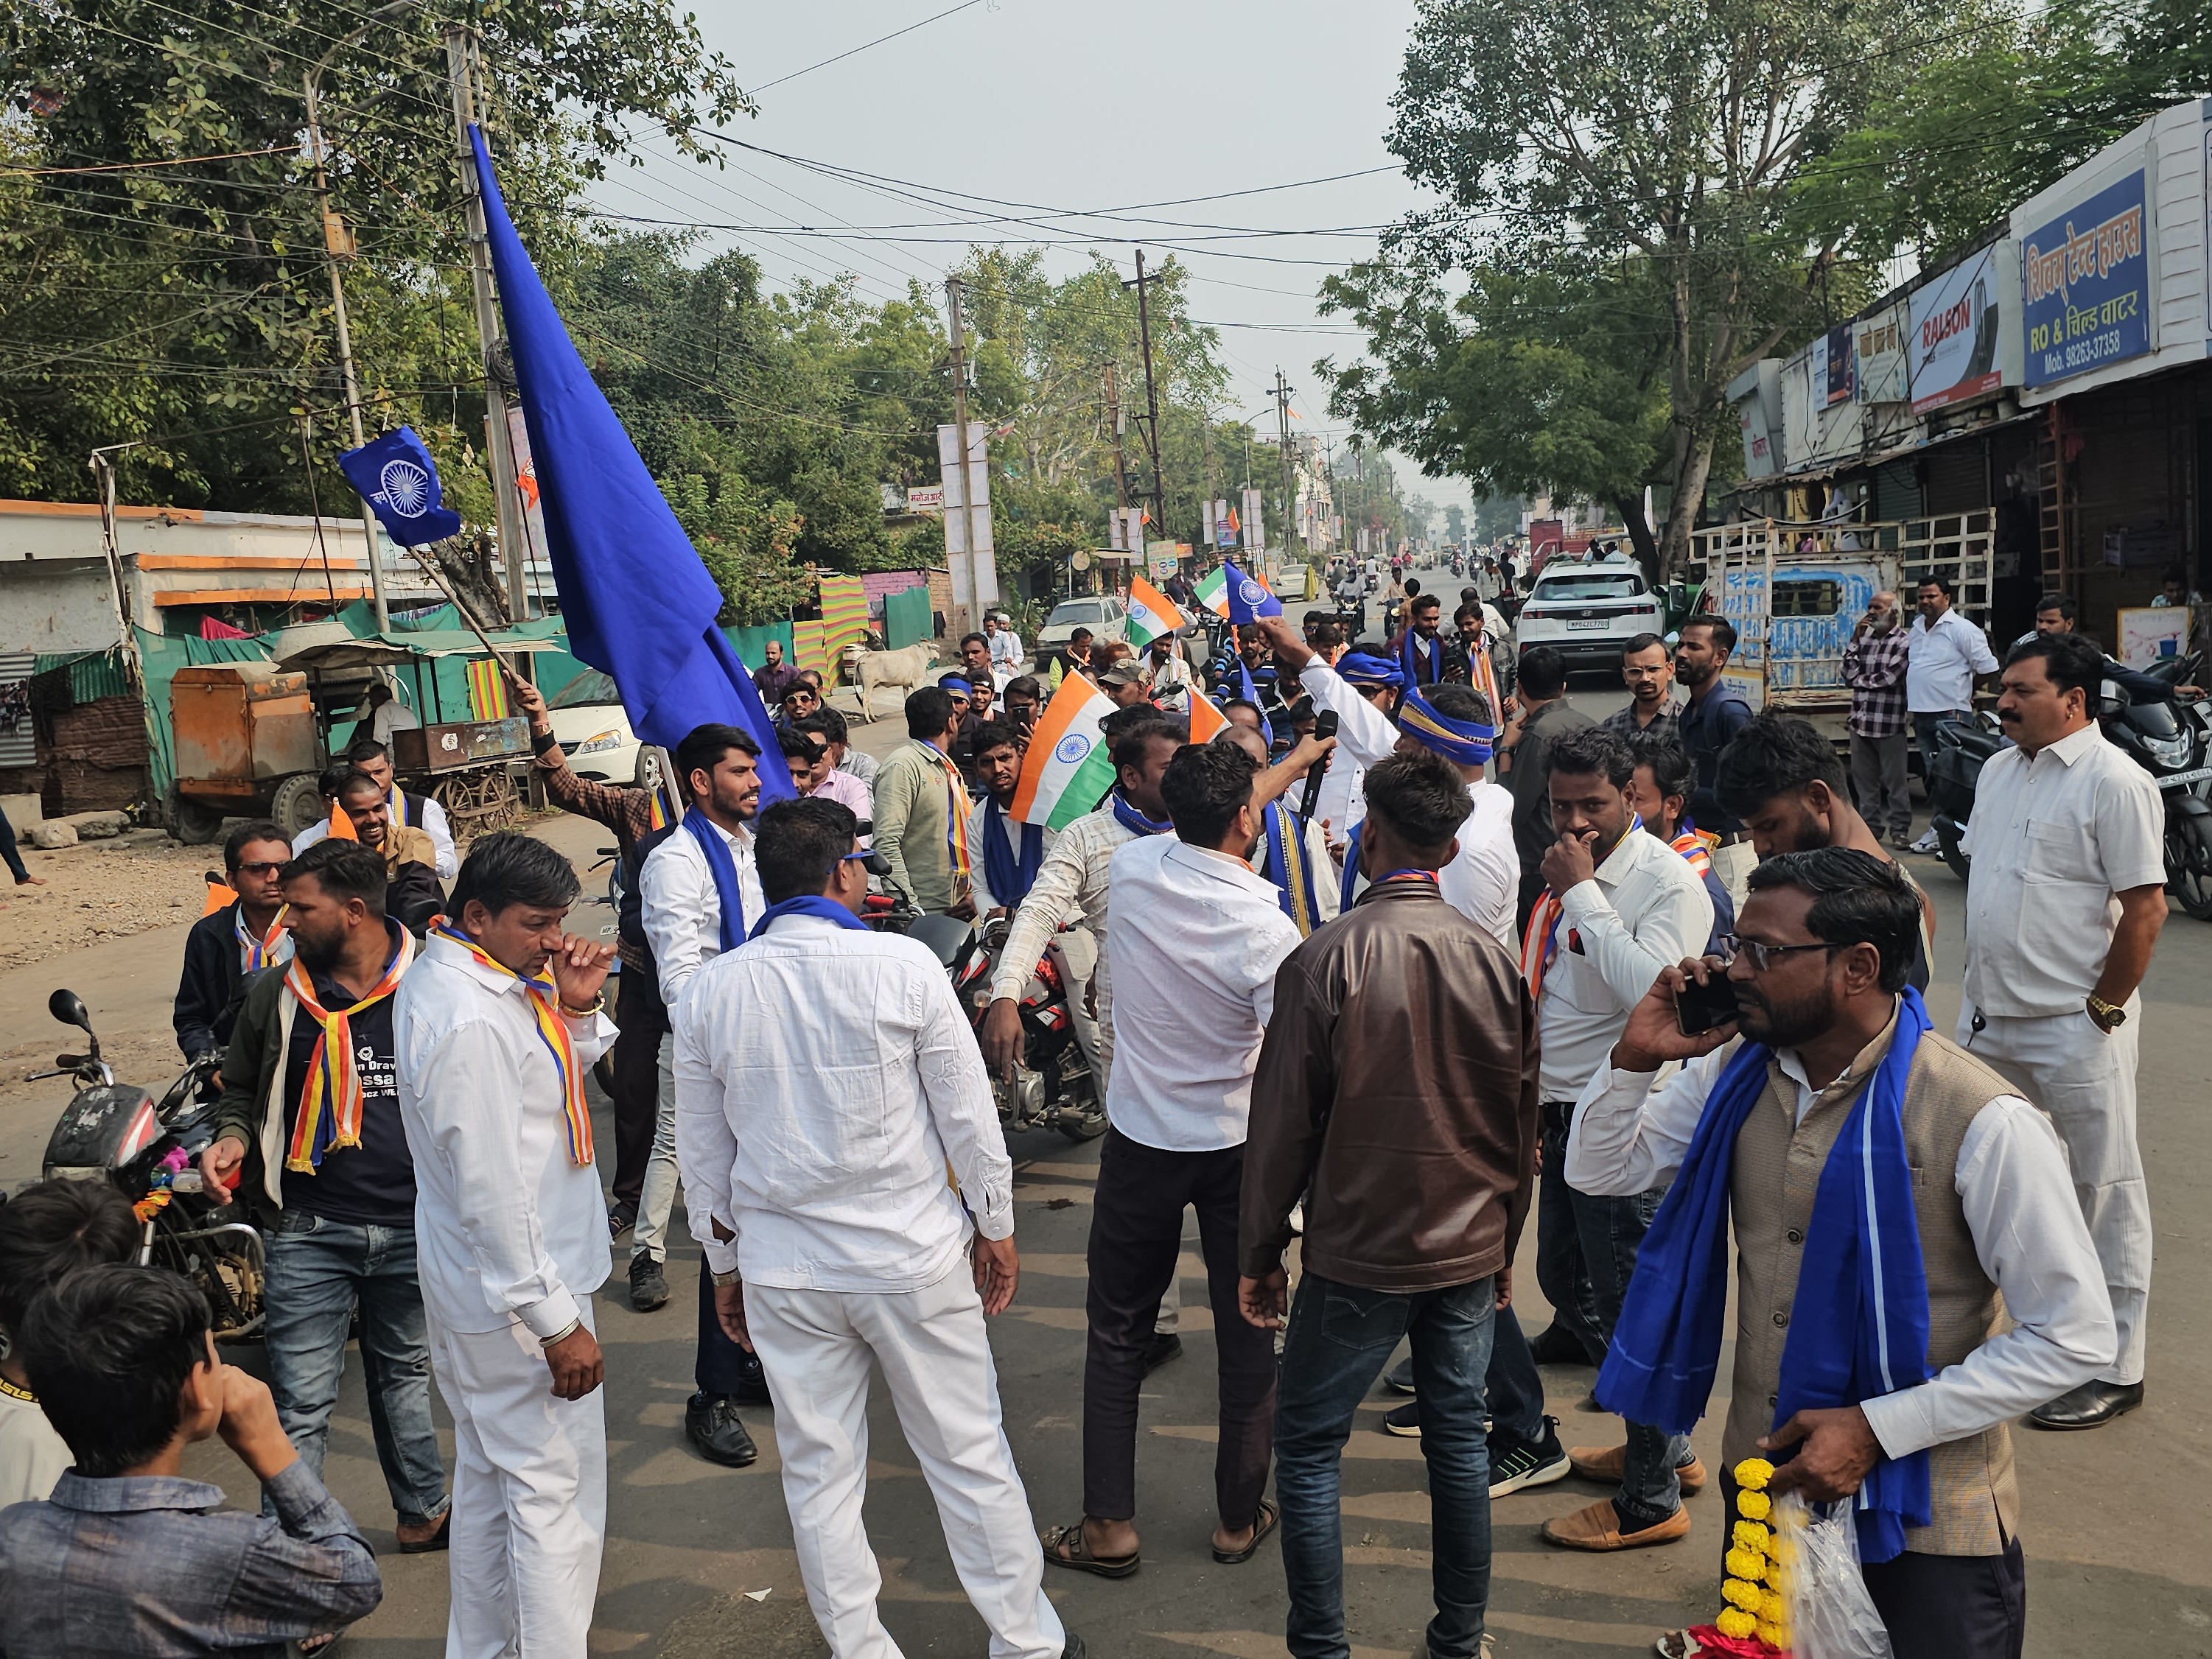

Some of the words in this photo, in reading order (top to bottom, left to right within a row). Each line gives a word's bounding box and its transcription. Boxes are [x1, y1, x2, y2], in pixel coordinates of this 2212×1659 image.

[2096, 203, 2141, 279] हाउस
[1922, 298, 1970, 349] RALSON
[2031, 323, 2048, 354] RO
[2053, 318, 2062, 345] &
[2101, 290, 2138, 325] वाटर
[2045, 351, 2064, 374] Mob.
[2065, 329, 2120, 368] 98263-37358
[363, 1074, 394, 1086] ssa
[368, 1060, 396, 1070] Drav
